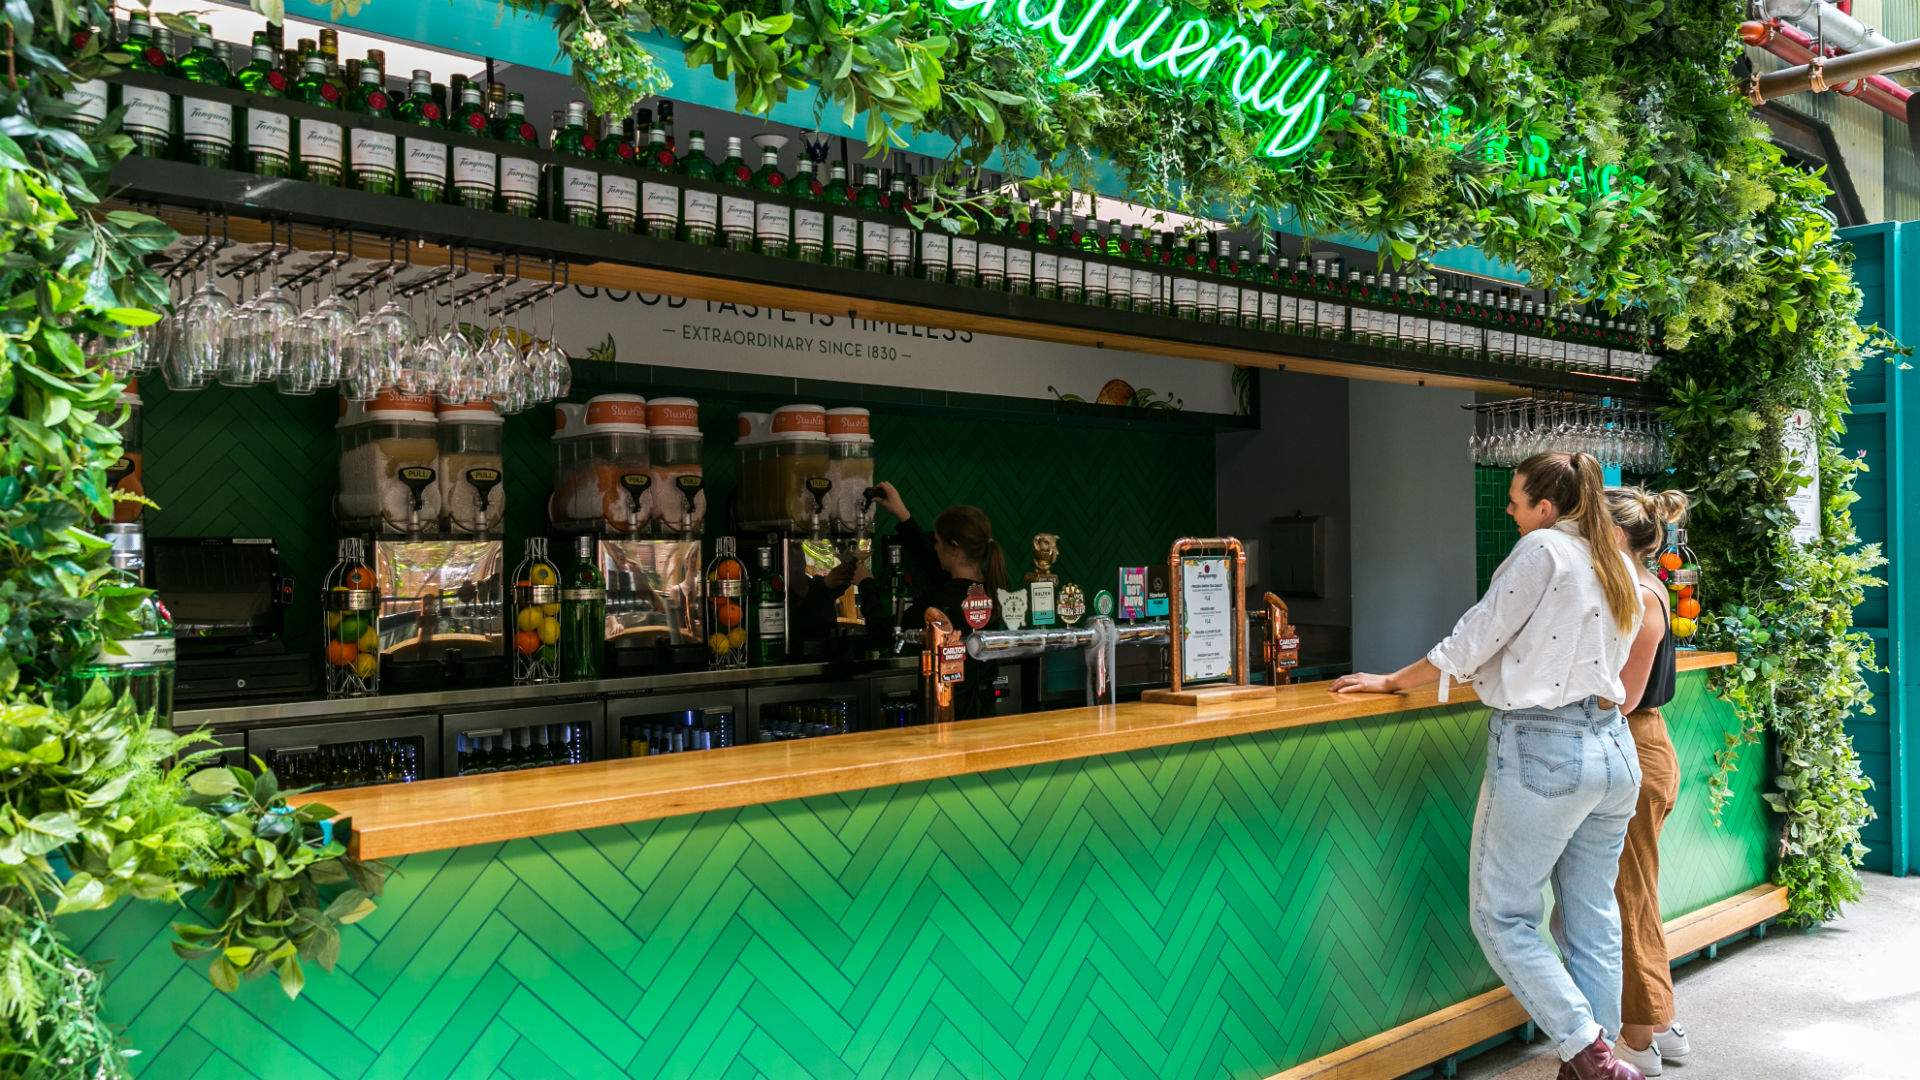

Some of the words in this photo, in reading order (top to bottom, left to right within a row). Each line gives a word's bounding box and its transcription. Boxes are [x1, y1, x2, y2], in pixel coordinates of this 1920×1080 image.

[682, 325, 814, 352] EXTRAORDINARY
[819, 340, 862, 357] SINCE
[867, 345, 897, 361] 1830
[943, 646, 966, 655] CARLTON
